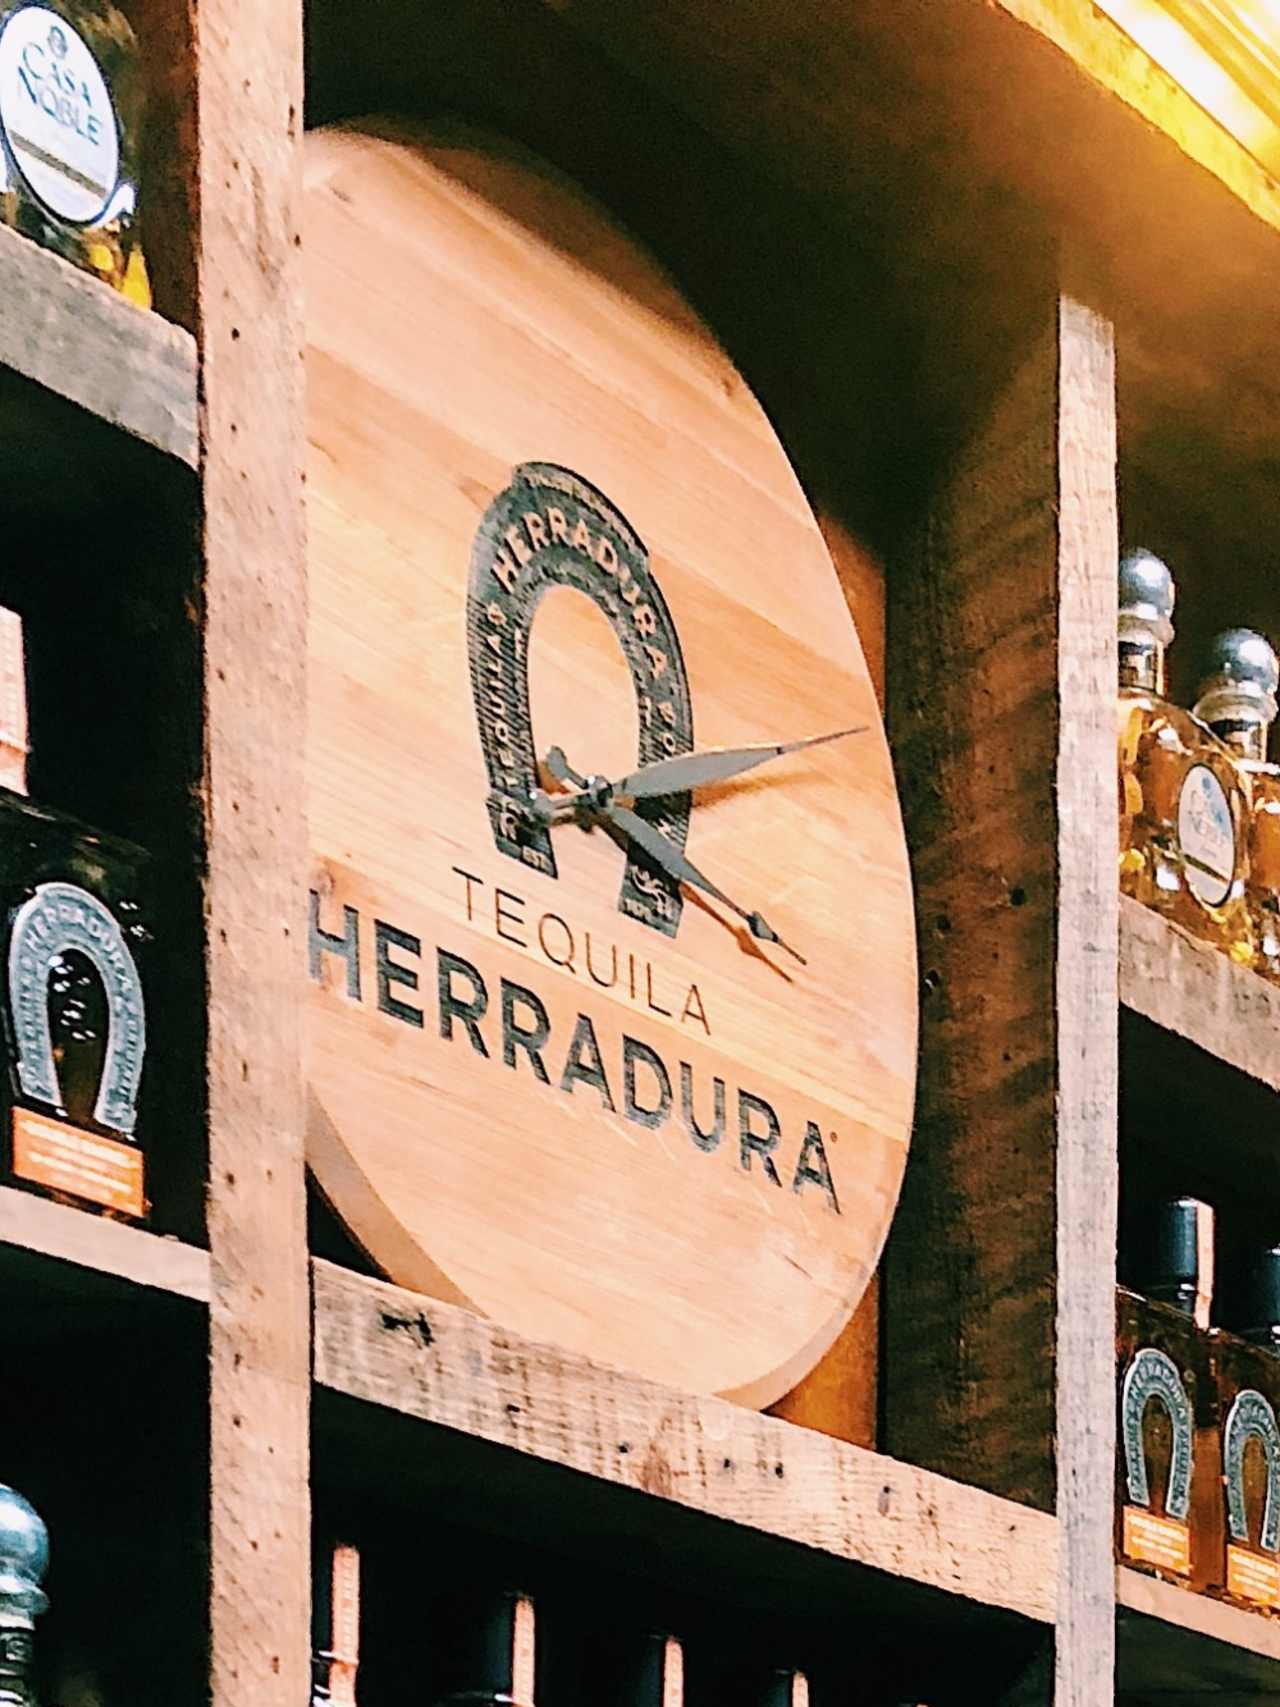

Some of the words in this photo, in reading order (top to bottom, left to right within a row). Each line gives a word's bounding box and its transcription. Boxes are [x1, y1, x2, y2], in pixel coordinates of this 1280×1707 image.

[489, 506, 668, 681] HERRADURA
[452, 866, 712, 1036] TEQUILA
[308, 888, 843, 1216] HERRADURA
